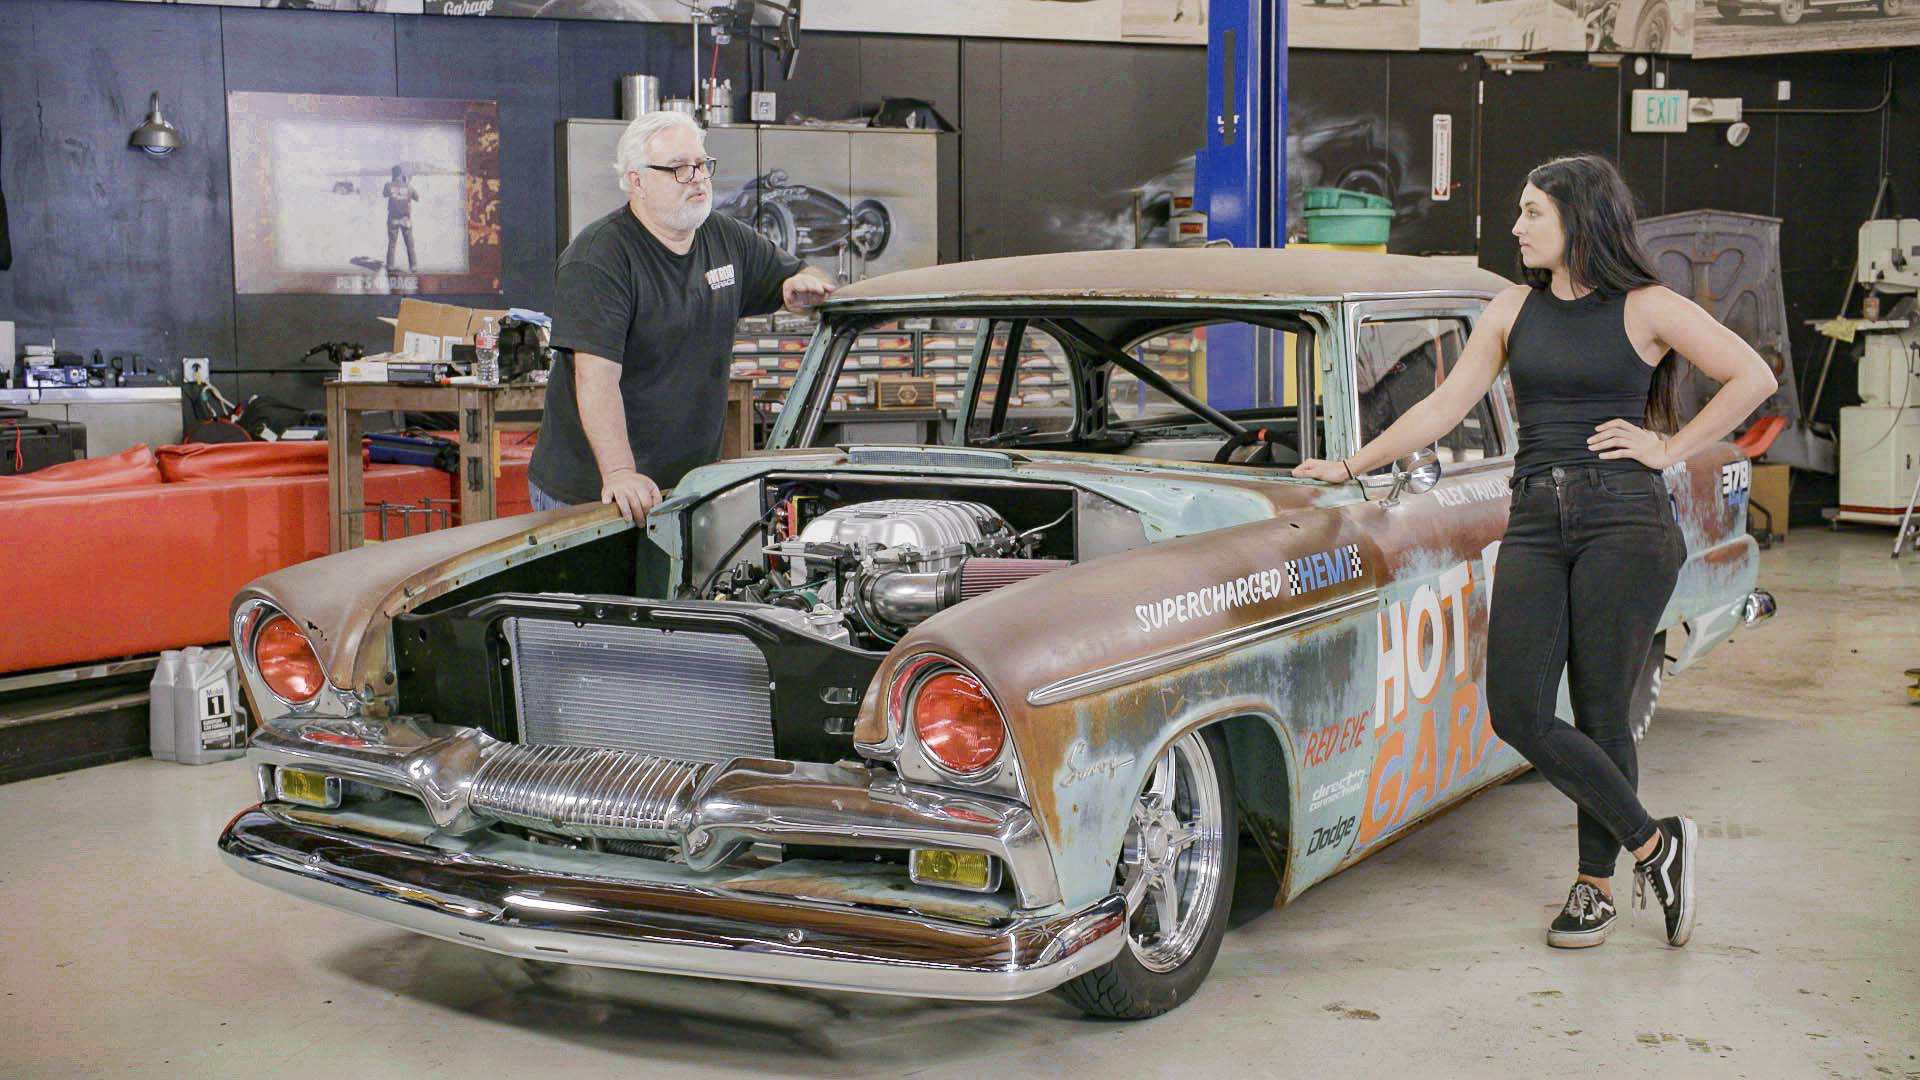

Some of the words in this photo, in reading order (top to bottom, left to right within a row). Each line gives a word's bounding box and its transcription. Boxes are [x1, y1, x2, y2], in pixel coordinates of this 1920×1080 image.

[443, 0, 494, 16] Garage
[1217, 115, 1240, 124] LT
[1647, 96, 1680, 126] EXIT
[1721, 460, 1748, 495] 378
[1432, 484, 1471, 508] ALEX
[1135, 568, 1282, 633] SUPERCHARGED
[1297, 546, 1352, 593] HEMI
[1375, 560, 1472, 737] HOT
[1306, 815, 1356, 857] Dodge
